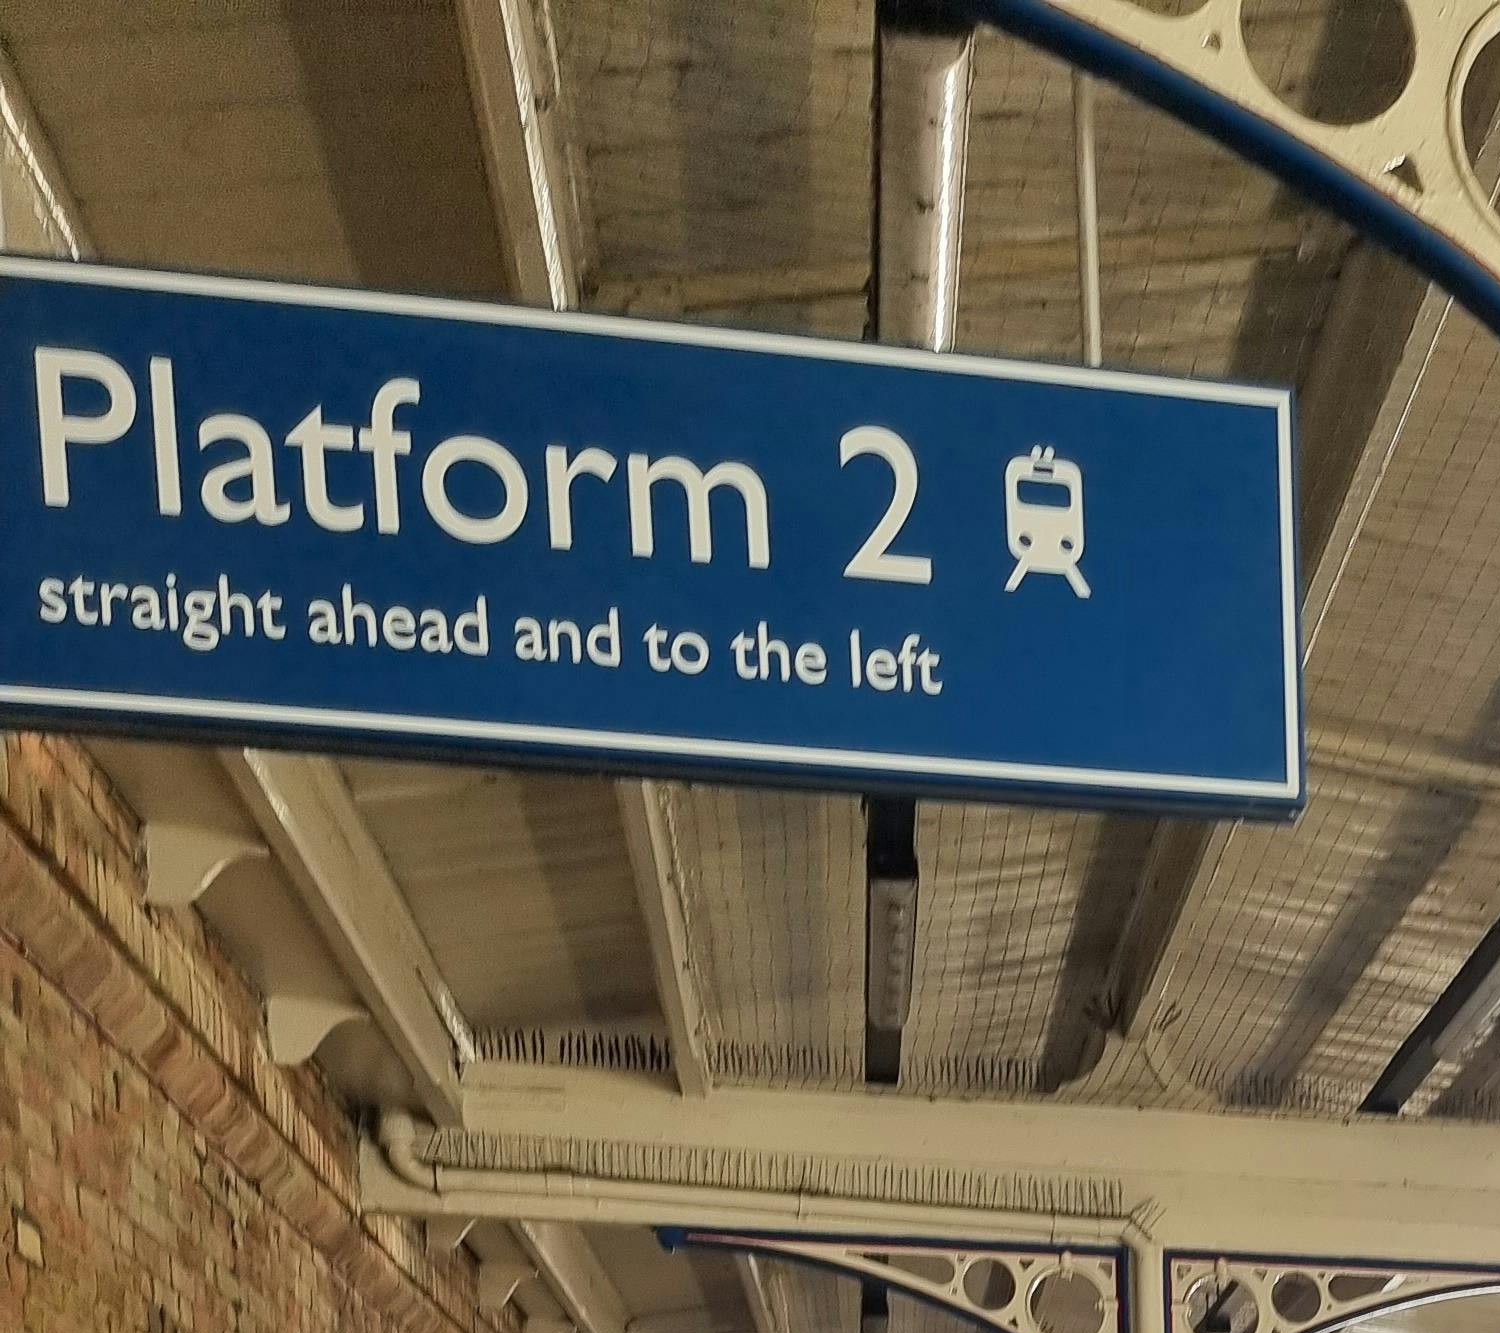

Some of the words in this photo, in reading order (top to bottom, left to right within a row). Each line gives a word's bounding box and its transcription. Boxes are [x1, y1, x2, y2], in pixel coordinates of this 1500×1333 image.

[33, 345, 771, 571] Platform
[838, 425, 934, 586] 2
[38, 573, 287, 652] straight
[307, 584, 490, 656] ahead
[513, 607, 622, 668] and
[643, 623, 710, 676] to
[730, 621, 828, 686] the
[850, 629, 944, 696] left
